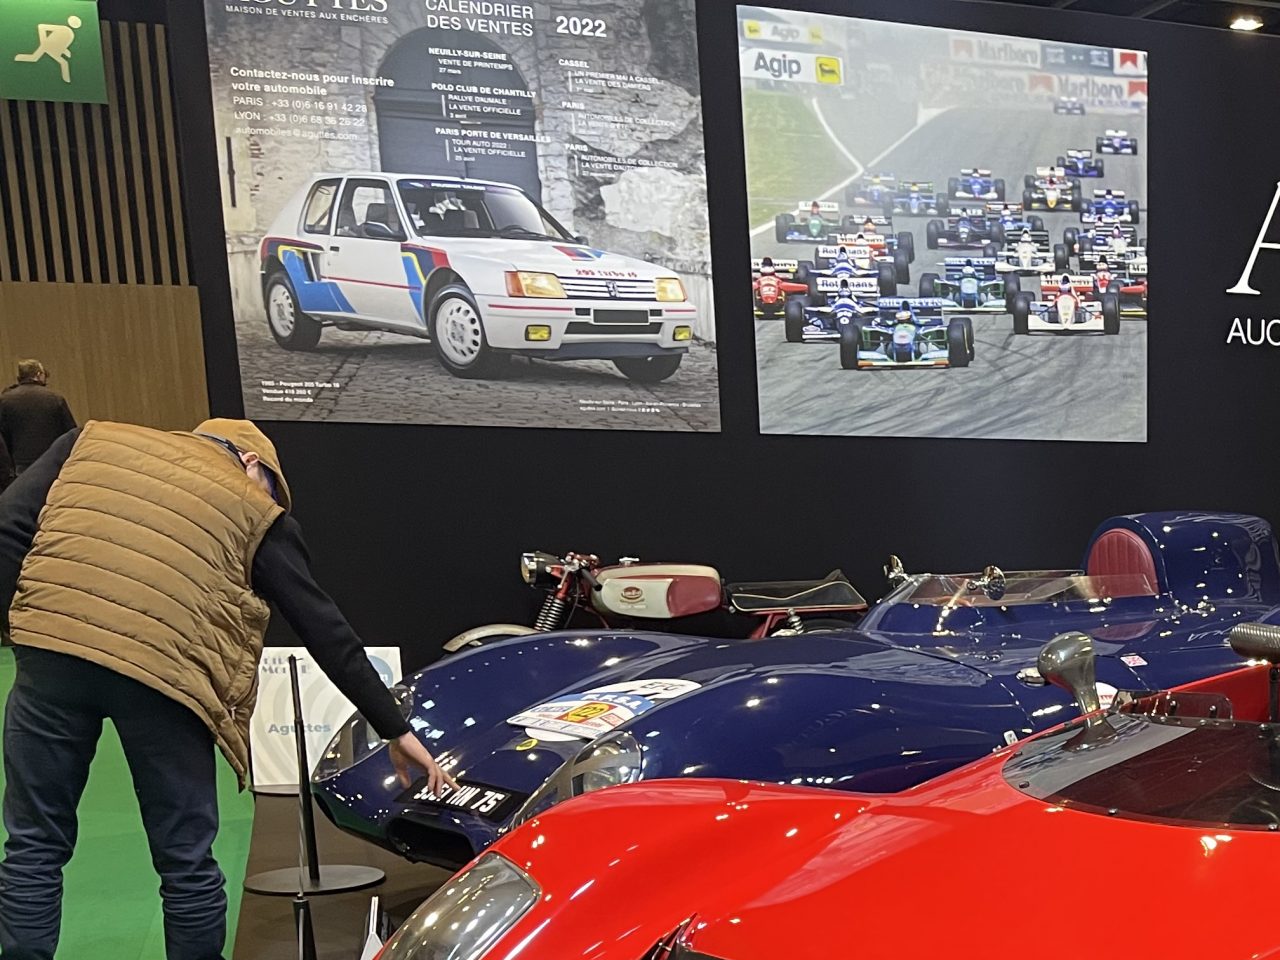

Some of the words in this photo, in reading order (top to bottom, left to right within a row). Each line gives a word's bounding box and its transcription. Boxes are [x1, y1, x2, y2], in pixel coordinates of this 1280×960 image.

[226, 5, 262, 14] MAISON
[281, 9, 316, 18] VENTES
[319, 12, 337, 20] AUX
[426, 0, 533, 19] CALENDRIER
[428, 15, 461, 30] DES
[466, 18, 533, 36] VENTES
[556, 16, 607, 37] 2022
[976, 40, 1038, 65] Marlboro
[559, 59, 589, 68] CASSEL
[754, 52, 801, 78] Agip
[230, 67, 319, 81] Contactez-nous
[323, 74, 349, 85] pour
[232, 82, 261, 92] votre
[264, 83, 327, 95] automobile
[432, 83, 454, 91] POLO
[493, 88, 536, 98] CHANTILLY
[1058, 77, 1124, 99] Marlboro
[233, 96, 263, 106] PARIS
[234, 111, 260, 121] LYON
[435, 127, 459, 135] PARIS
[461, 129, 488, 138] PORTE
[470, 791, 505, 812] 75
